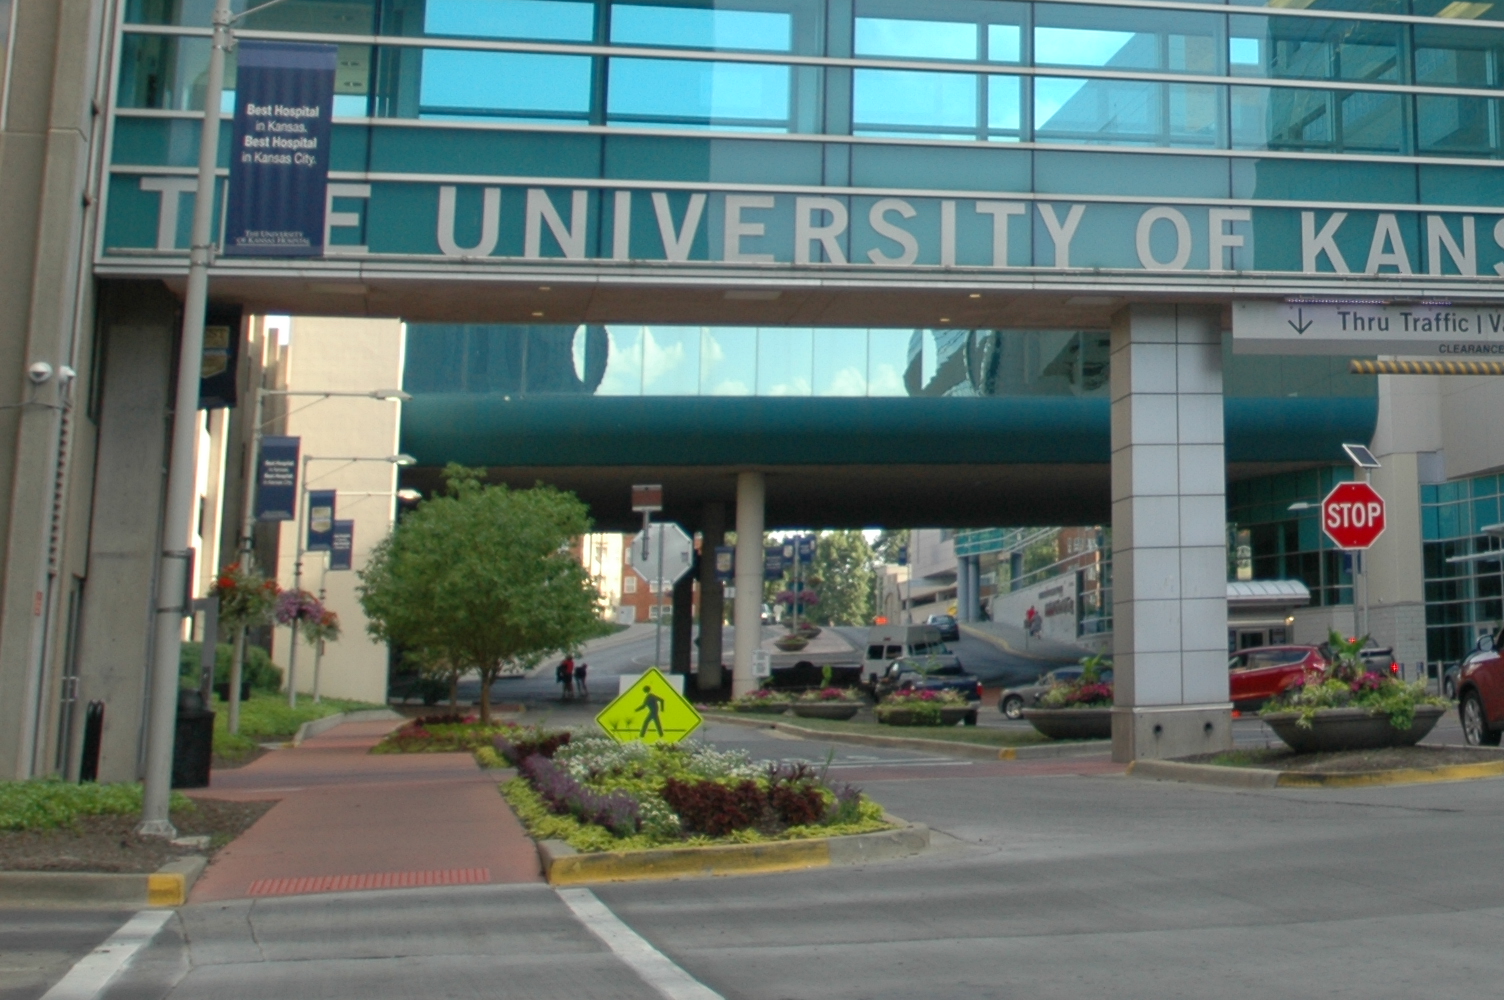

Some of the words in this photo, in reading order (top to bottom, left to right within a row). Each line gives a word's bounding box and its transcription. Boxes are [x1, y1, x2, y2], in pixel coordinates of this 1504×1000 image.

[246, 103, 272, 117] Best
[274, 104, 320, 119] Hospital
[255, 121, 266, 132] in
[267, 121, 308, 133] Kansas.
[244, 135, 270, 148] Best
[272, 136, 318, 151] Hospital
[241, 152, 252, 163] in
[254, 152, 292, 165] Kansas
[140, 177, 371, 254] TE
[437, 186, 1086, 269] UNIVERSITY
[1135, 207, 1251, 271] OF
[1337, 311, 1389, 331] Thru
[1400, 312, 1469, 332] Traffic
[1438, 344, 1504, 354] CLEARANCE
[1327, 502, 1381, 528] STOP
